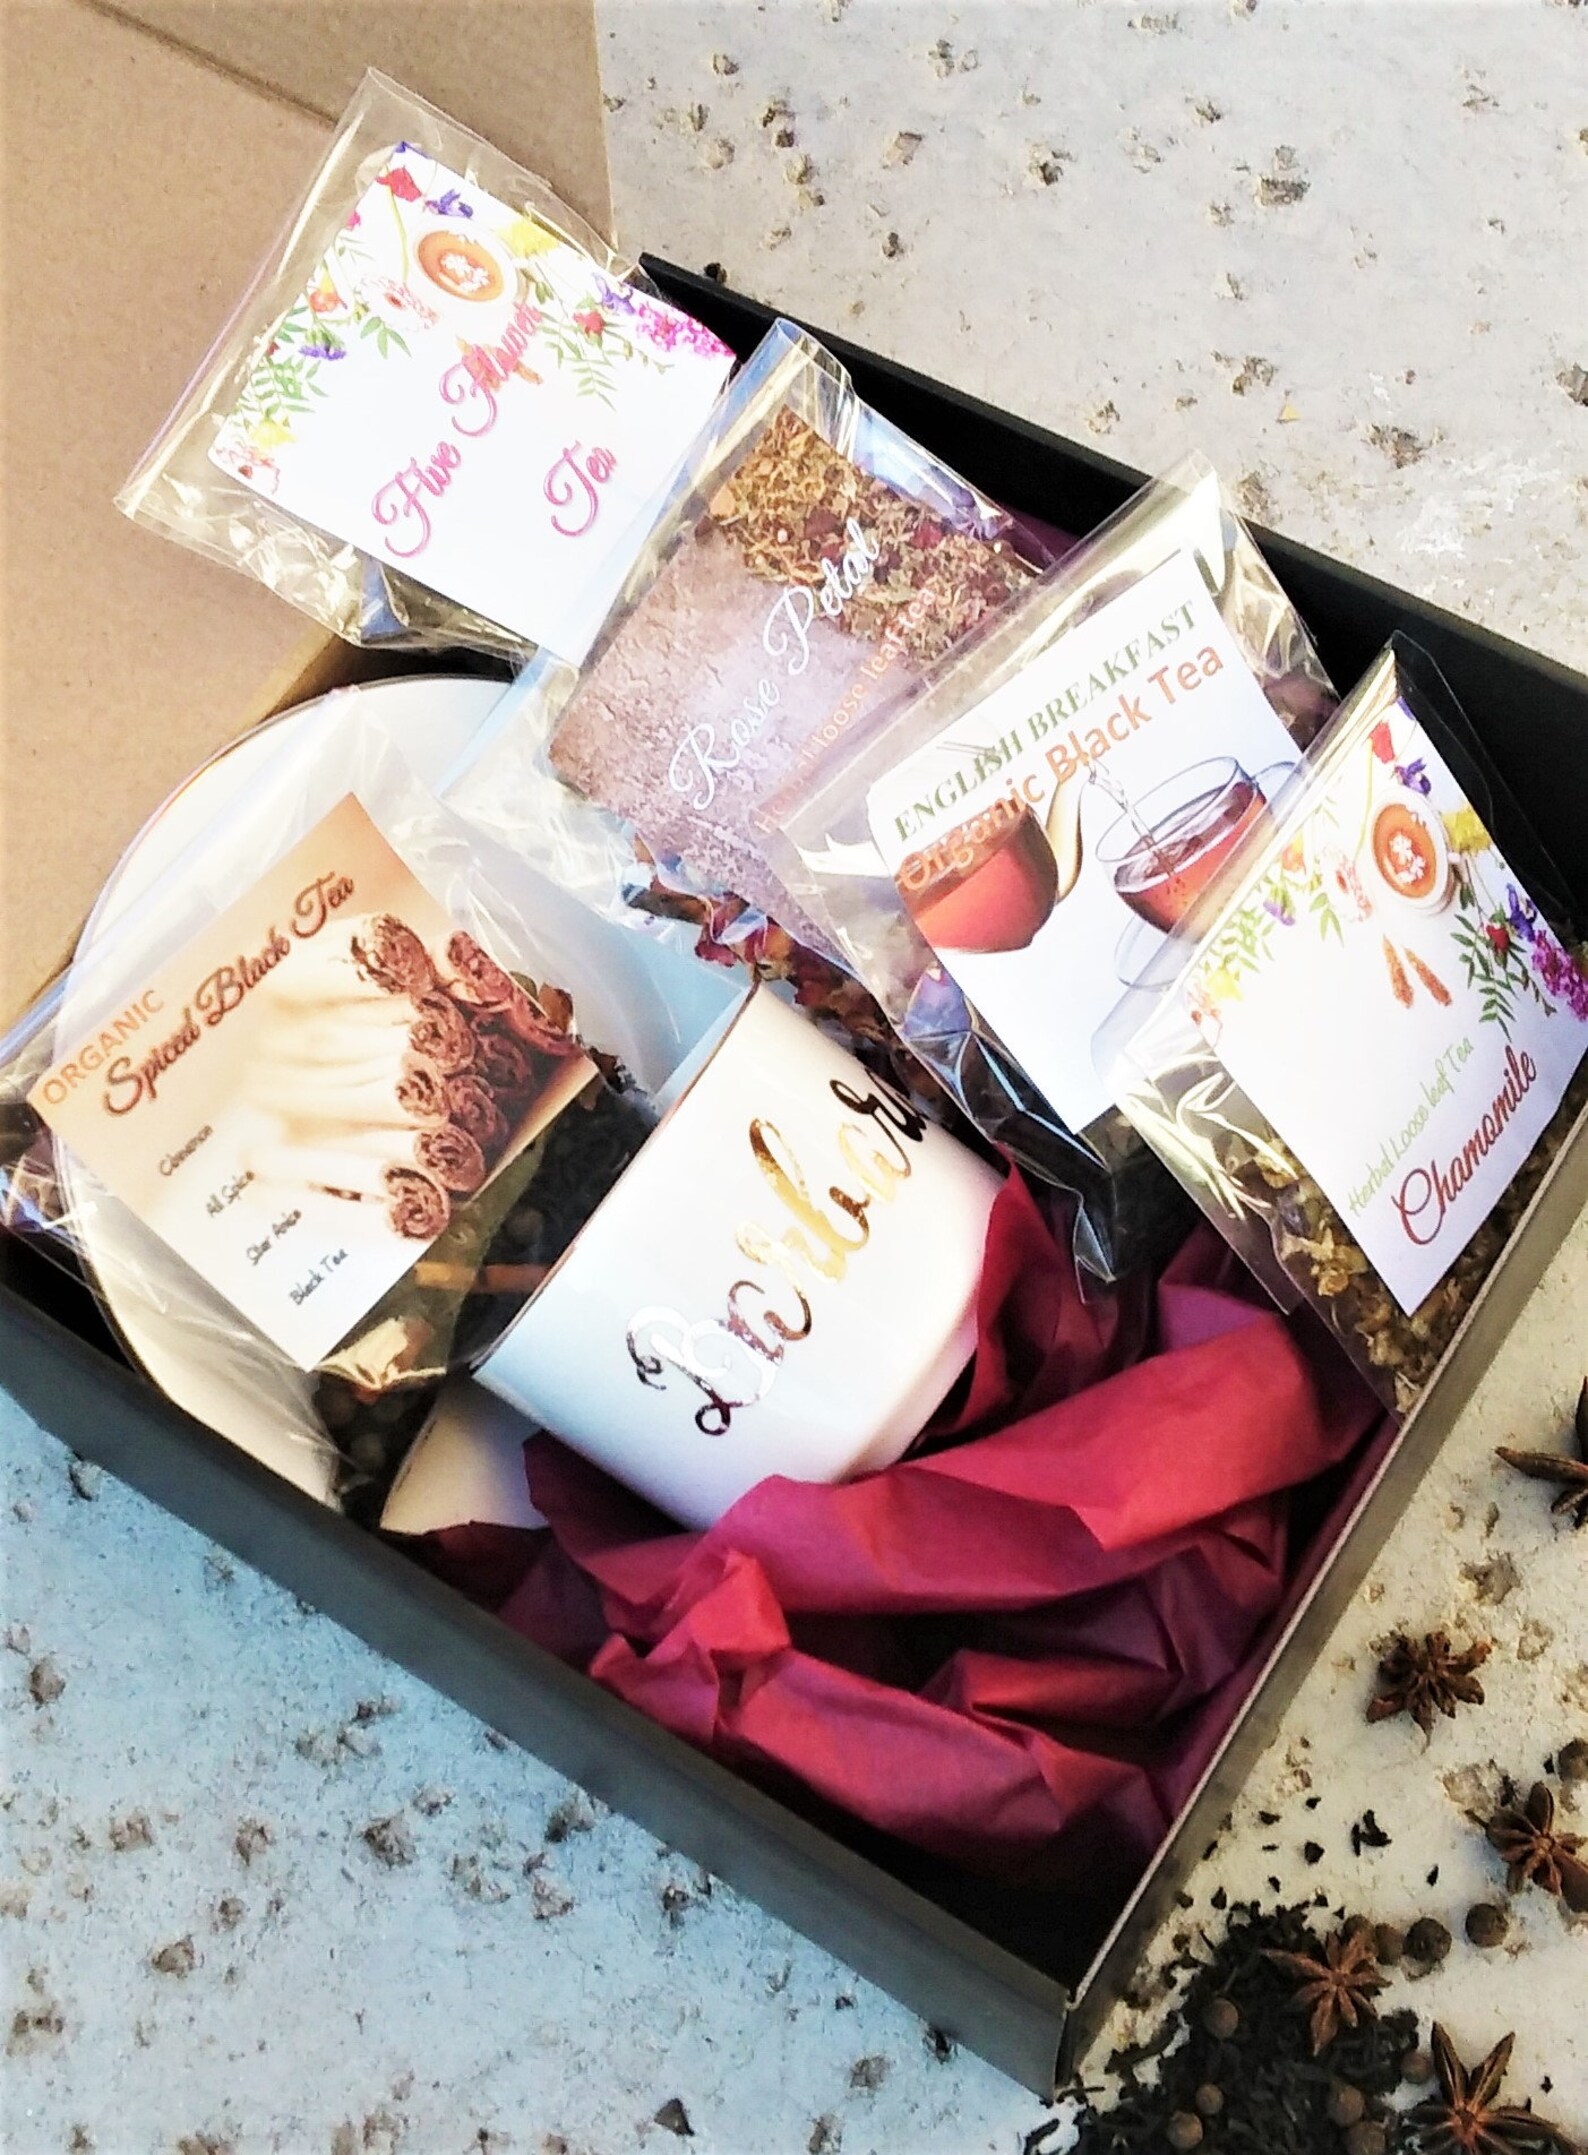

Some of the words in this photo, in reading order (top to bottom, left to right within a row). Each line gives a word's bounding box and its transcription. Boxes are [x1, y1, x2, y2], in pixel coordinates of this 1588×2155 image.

[372, 441, 461, 557] Five
[543, 441, 617, 537] Tea
[668, 677, 780, 810] Rose
[763, 516, 881, 676] Petal
[860, 627, 903, 680] leaf
[898, 587, 935, 630] tea
[893, 729, 1024, 842] ENGLISH
[1027, 599, 1196, 742] BREAKFAST
[899, 773, 1047, 891] Organic
[1044, 693, 1152, 783] Black
[1147, 645, 1224, 706] Tea
[42, 989, 165, 1106] ORGANIC
[102, 1008, 202, 1118] Spiced
[194, 925, 291, 1027] Black
[290, 871, 355, 939] Tea
[1349, 1139, 1395, 1218] Herbal
[1389, 1104, 1429, 1162] Loose
[1445, 1037, 1474, 1073] Tea
[1391, 1044, 1537, 1246] Chamomile
[289, 1270, 325, 1305] Black
[320, 1249, 348, 1273] Tea
